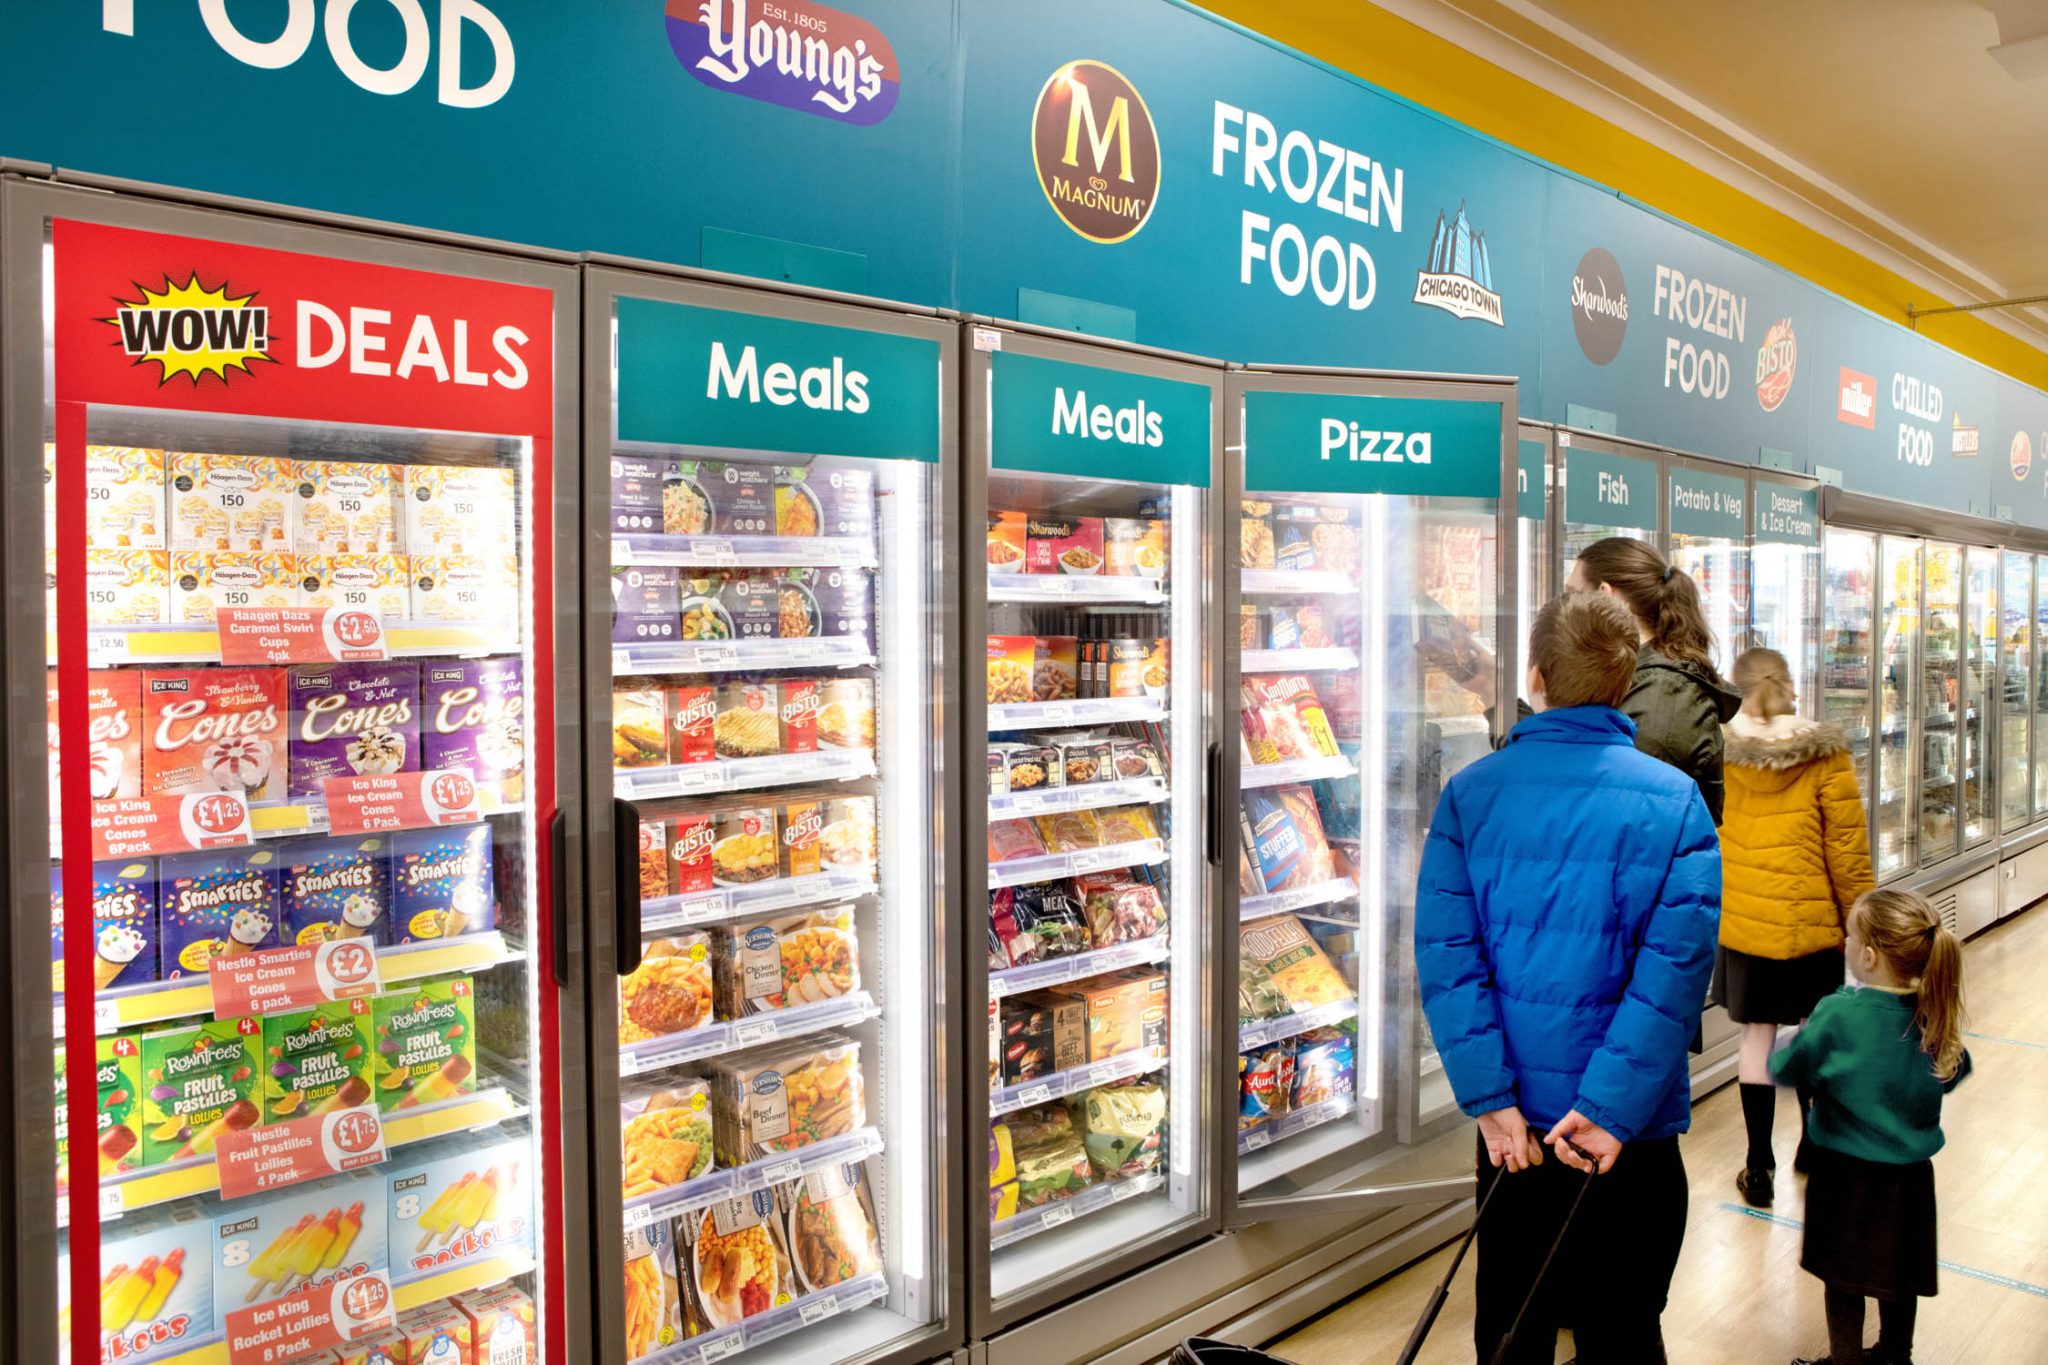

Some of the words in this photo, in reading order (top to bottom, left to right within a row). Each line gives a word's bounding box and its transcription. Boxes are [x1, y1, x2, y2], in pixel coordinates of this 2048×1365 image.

[696, 0, 884, 113] Young's
[1211, 100, 1404, 233] FROZEN
[1052, 175, 1140, 221] MAGNUM
[1240, 209, 1376, 311] FOOD
[1418, 276, 1469, 301] CHICAGO
[1468, 285, 1501, 316] TOWN
[1571, 274, 1629, 321] Sharwood's
[1653, 264, 1746, 343] FROZEN
[118, 307, 268, 355] WOW!
[296, 298, 530, 390] DEALS
[1664, 336, 1730, 400] FOOD
[1755, 340, 1794, 385] BISTO
[706, 341, 869, 414] Meals
[1892, 371, 1943, 423] CHILLED
[1050, 386, 1164, 448] Meals
[1320, 418, 1432, 465] Pizza
[1897, 422, 1934, 467] FOOD
[1598, 471, 1629, 506] Fish
[220, 494, 245, 507] 150
[339, 500, 361, 512] 150
[454, 502, 474, 514] 150
[1674, 484, 1711, 511] Potato
[1713, 491, 1720, 511] &
[1722, 494, 1742, 520] Veg
[1771, 491, 1803, 516] Dessert
[1029, 520, 1070, 537] Sharwood's
[1761, 515, 1767, 531] &
[1769, 512, 1784, 533] Ice
[1785, 515, 1812, 538] Cream
[89, 590, 115, 604] 150
[225, 592, 249, 605] 150
[344, 592, 367, 604] 150
[456, 591, 477, 603] 150
[233, 610, 279, 622] Haagen
[282, 611, 310, 621] Dazs
[230, 623, 280, 634] Caramel
[283, 623, 314, 633] Swirl
[339, 616, 377, 641] £2.50
[259, 636, 290, 648] Cups
[267, 650, 291, 662] 4pk
[153, 680, 166, 690] ICE
[168, 679, 187, 690] KING
[299, 677, 311, 687] ICE
[312, 676, 329, 686] KING
[348, 676, 391, 691] Chocolate
[434, 672, 445, 680] ICE
[446, 671, 461, 680] KING
[205, 682, 260, 697] Strawberry
[376, 687, 398, 700] Nut
[230, 693, 268, 706] Vanilla
[783, 694, 819, 721] BISTO
[301, 693, 412, 742] Cones
[676, 700, 717, 730] BISTO
[154, 699, 278, 751] Cones
[352, 779, 369, 790] Ice
[372, 778, 397, 790] King
[435, 777, 471, 804] £1.25
[347, 793, 365, 803] Ice
[367, 790, 404, 802] Cream
[96, 802, 117, 814] Ice
[120, 801, 151, 812] King
[198, 799, 241, 827] £1.25
[361, 804, 396, 816] Cones
[114, 813, 158, 826] Cream
[363, 818, 371, 829] 6
[374, 816, 401, 828] Pack
[105, 829, 147, 841] Cones
[784, 815, 822, 844] BISTO
[673, 828, 715, 861] BISTO
[1260, 825, 1296, 860] STUFFED
[1042, 895, 1068, 913] MEAT
[216, 956, 256, 972] Nestle
[259, 949, 313, 966] Smarties
[332, 948, 368, 978] £2
[745, 963, 774, 975] Chicken
[235, 971, 254, 984] Ice
[257, 966, 296, 980] Cream
[754, 969, 780, 980] Dinner
[249, 981, 286, 997] Cones
[455, 982, 464, 995] 4
[250, 1000, 259, 1011] 6
[262, 995, 292, 1011] pack
[352, 999, 364, 1014] 4
[241, 1018, 253, 1034] 4
[1057, 1009, 1065, 1026] 4
[116, 1039, 130, 1055] 4
[1061, 1041, 1079, 1056] BEEF
[1249, 1072, 1276, 1088] Aunt
[752, 1105, 773, 1119] Beef
[760, 1111, 787, 1124] Dinner
[251, 1126, 291, 1144] Nestle
[338, 1117, 376, 1147] £1.75
[229, 1148, 259, 1164] Fruit
[261, 1136, 313, 1156] Pastilles
[254, 1156, 294, 1173] Lollies
[257, 1175, 265, 1187] 4
[268, 1170, 299, 1185] Pack
[395, 1182, 407, 1190] ICE
[408, 1175, 426, 1186] KING
[396, 1193, 420, 1220] 8
[728, 1198, 739, 1228] reakfast
[222, 1225, 236, 1236] ICE
[237, 1219, 256, 1232] KING
[222, 1239, 250, 1268] 8
[347, 1282, 385, 1315] £1.25
[253, 1310, 275, 1325] Ice
[278, 1298, 310, 1318] King
[233, 1329, 283, 1351] Rocket
[285, 1313, 331, 1335] Lollies
[263, 1348, 273, 1362] 8
[277, 1337, 311, 1358] Pack
[493, 1345, 523, 1364] FRESH
